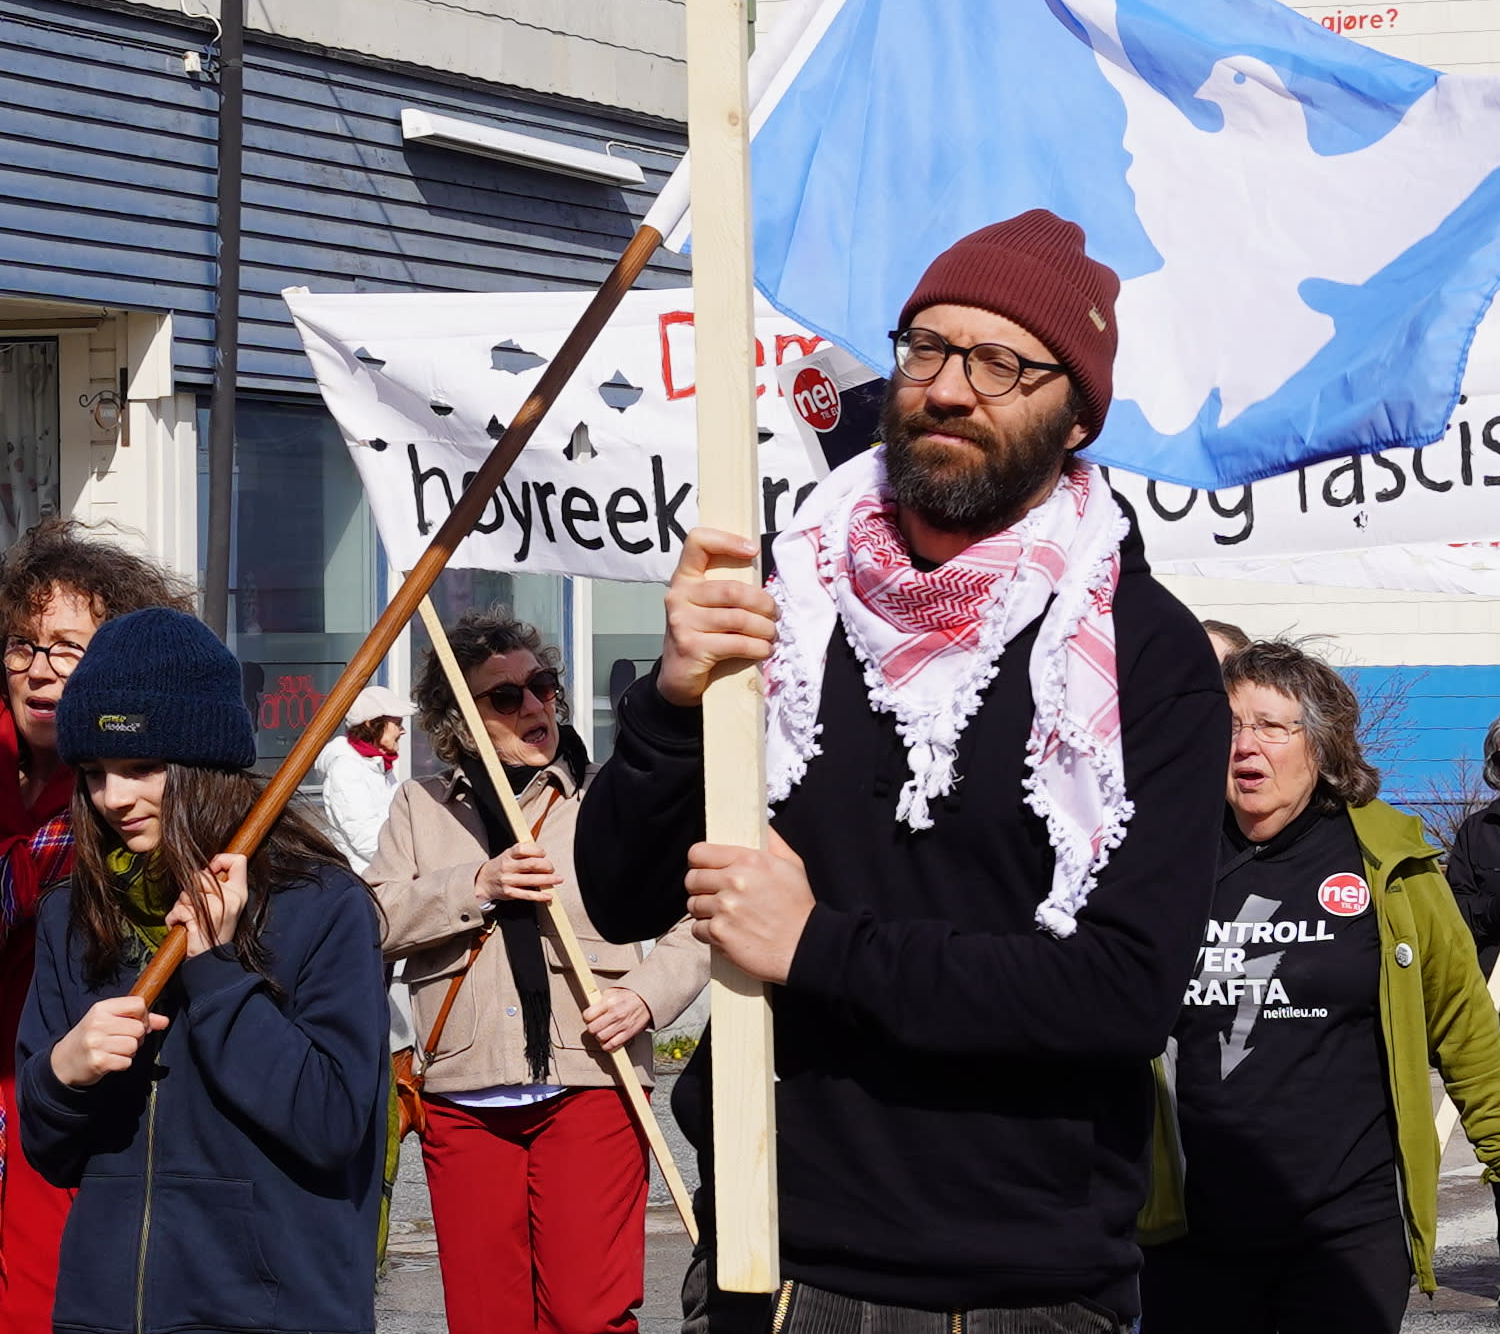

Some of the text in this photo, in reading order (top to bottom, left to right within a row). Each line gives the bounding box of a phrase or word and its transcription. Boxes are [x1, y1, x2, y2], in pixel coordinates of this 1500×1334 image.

[794, 370, 838, 418] nei
[1322, 880, 1366, 905] nei
[1206, 919, 1335, 944] NTROLL
[1183, 978, 1290, 1006] RAFTA
[1263, 1006, 1328, 1019] neitileu.no
